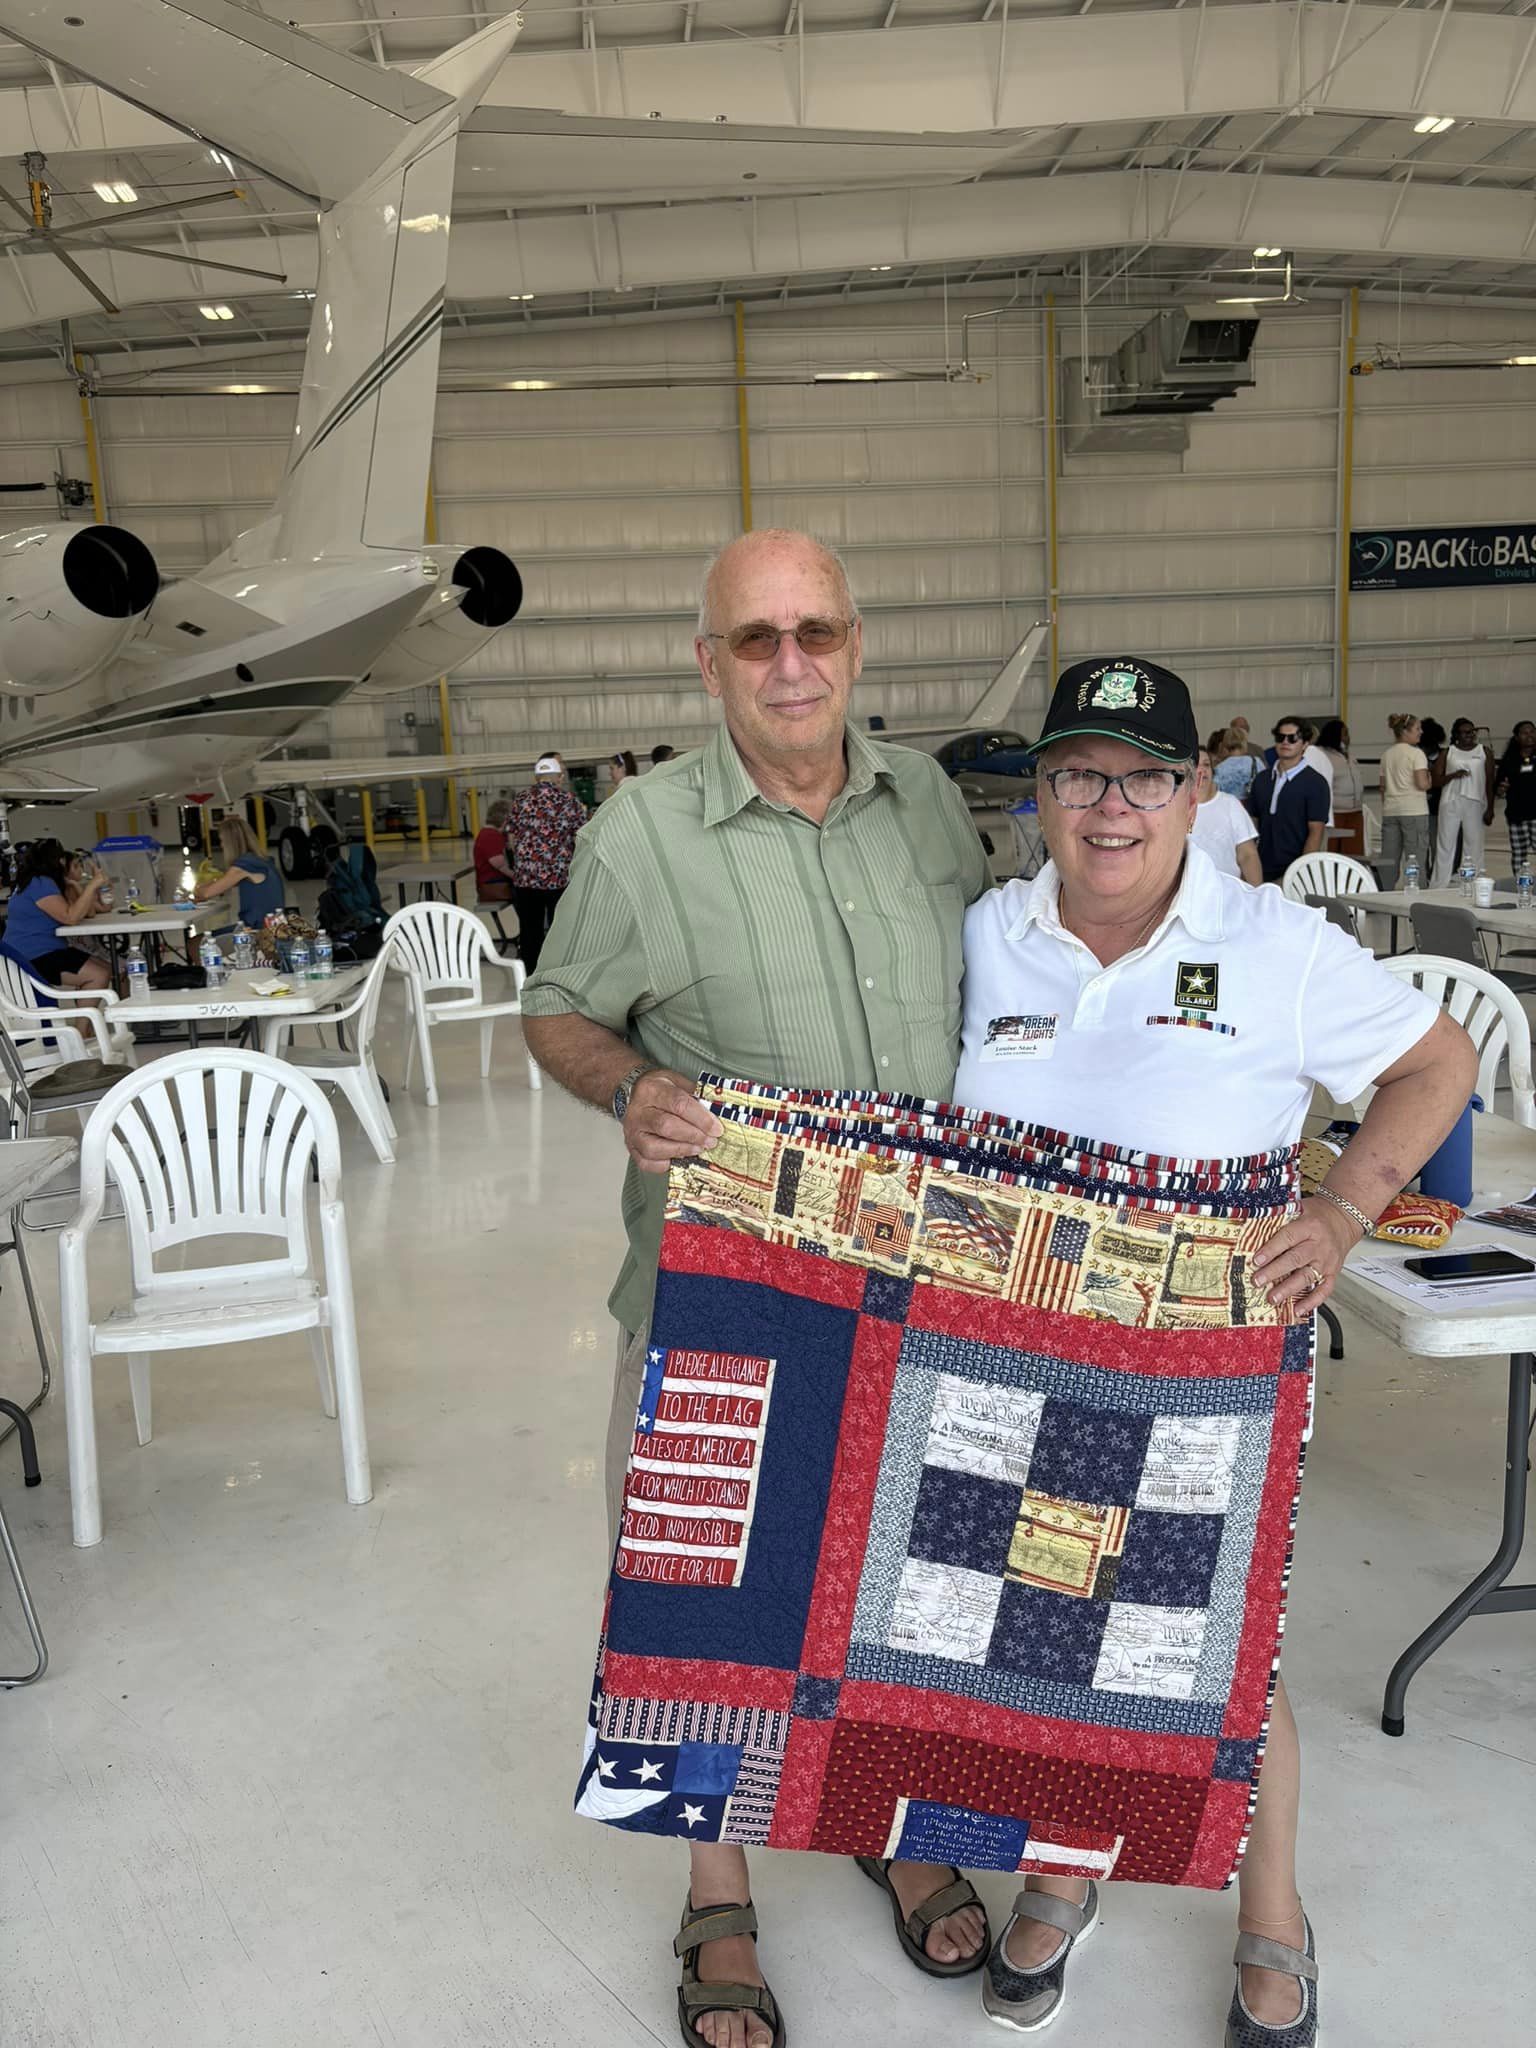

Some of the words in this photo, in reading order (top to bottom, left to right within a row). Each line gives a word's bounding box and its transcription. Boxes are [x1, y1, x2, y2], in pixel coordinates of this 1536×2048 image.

[1022, 1028, 1055, 1040] FLIGHTS
[1024, 1016, 1056, 1029] DREAM
[668, 1351, 675, 1374] I
[674, 1351, 709, 1377] PLEDGE
[708, 1352, 767, 1383] ALLEGIANCE
[662, 1392, 682, 1420] TO
[686, 1395, 712, 1422] THE
[714, 1397, 755, 1425] FLAG
[675, 1439, 691, 1460] OF
[689, 1437, 751, 1466] AMERICA
[641, 1474, 662, 1498] FOR
[663, 1477, 694, 1502] WHICH
[696, 1479, 708, 1502] IT
[707, 1480, 748, 1506] STANDS
[665, 1519, 737, 1545] INDIVISIBLE
[631, 1555, 679, 1581] JUSTICE
[680, 1558, 704, 1583] FOR
